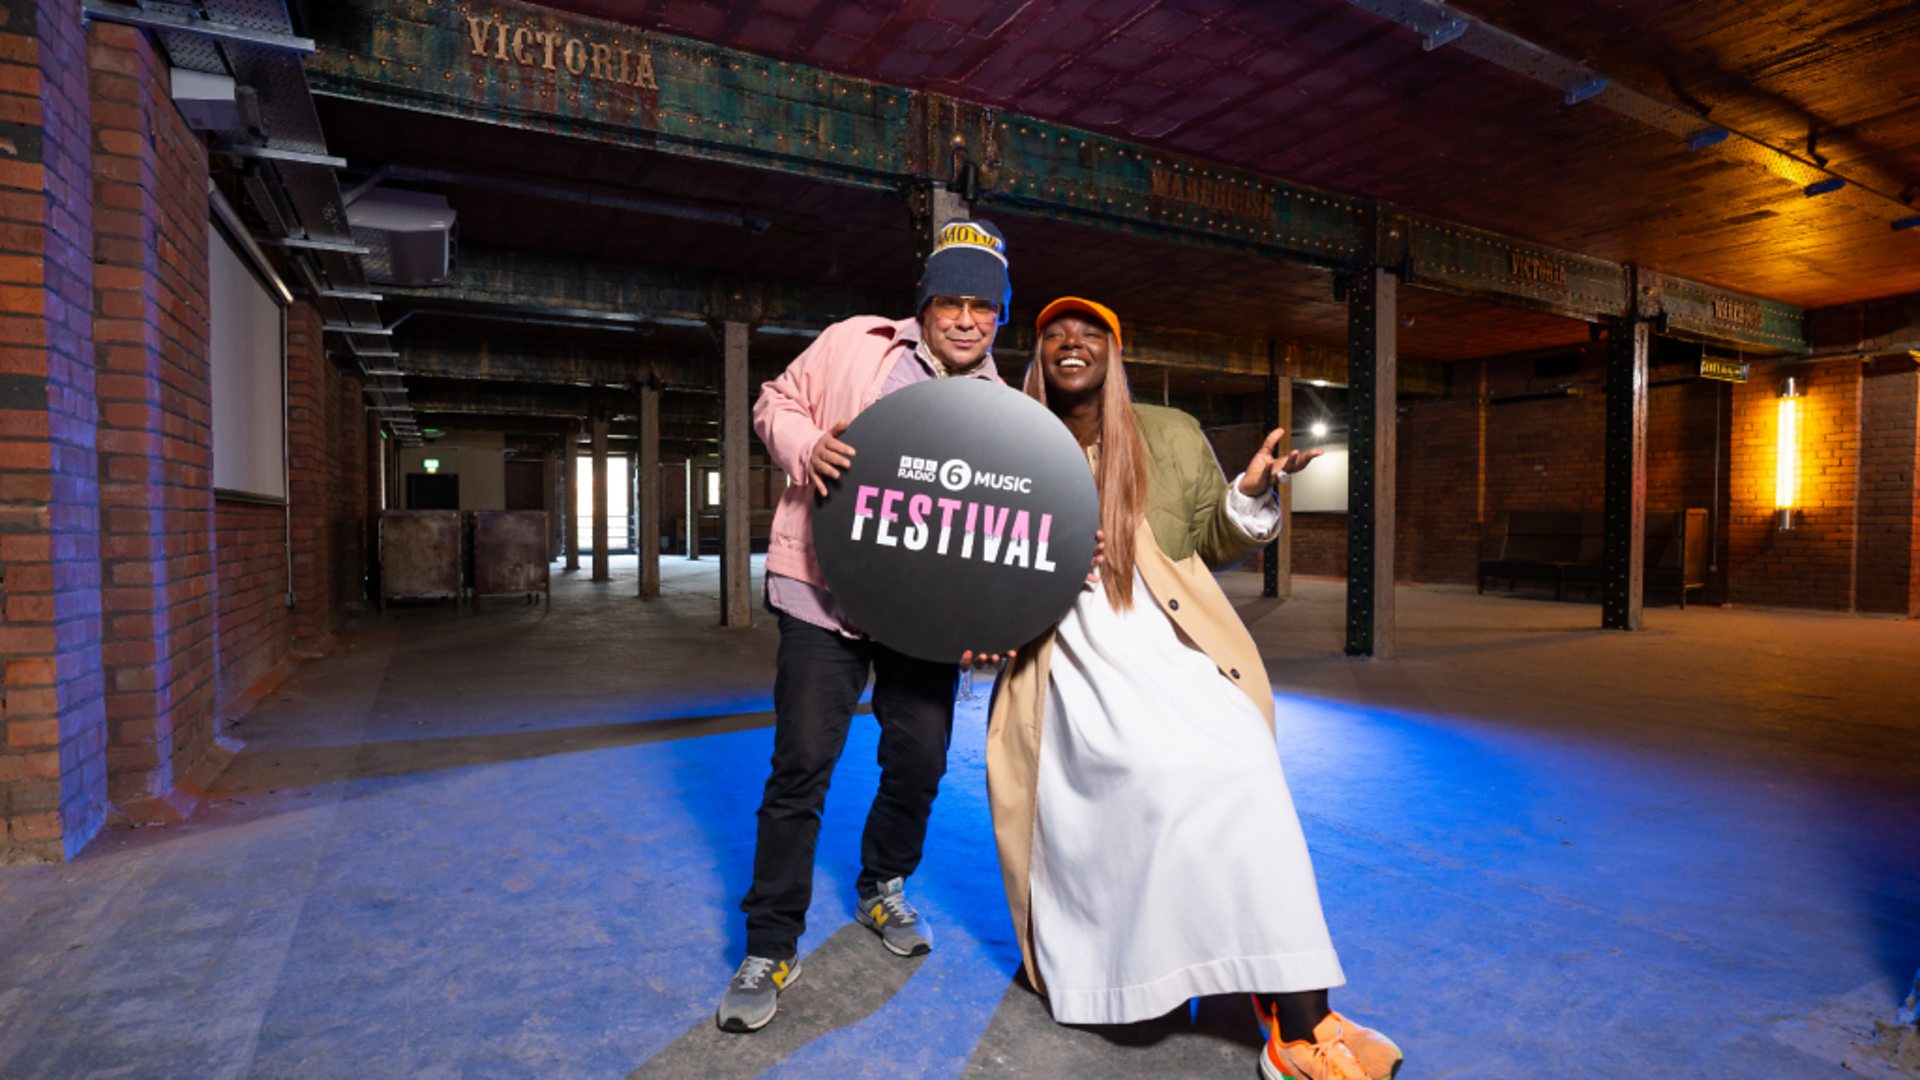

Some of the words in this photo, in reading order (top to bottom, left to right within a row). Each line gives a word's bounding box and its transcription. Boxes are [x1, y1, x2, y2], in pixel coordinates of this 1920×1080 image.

[466, 16, 659, 90] VICTORIA
[898, 468, 936, 482] RADIO
[974, 471, 1032, 493] MUSIC
[851, 485, 1056, 572] FESTIVAL
